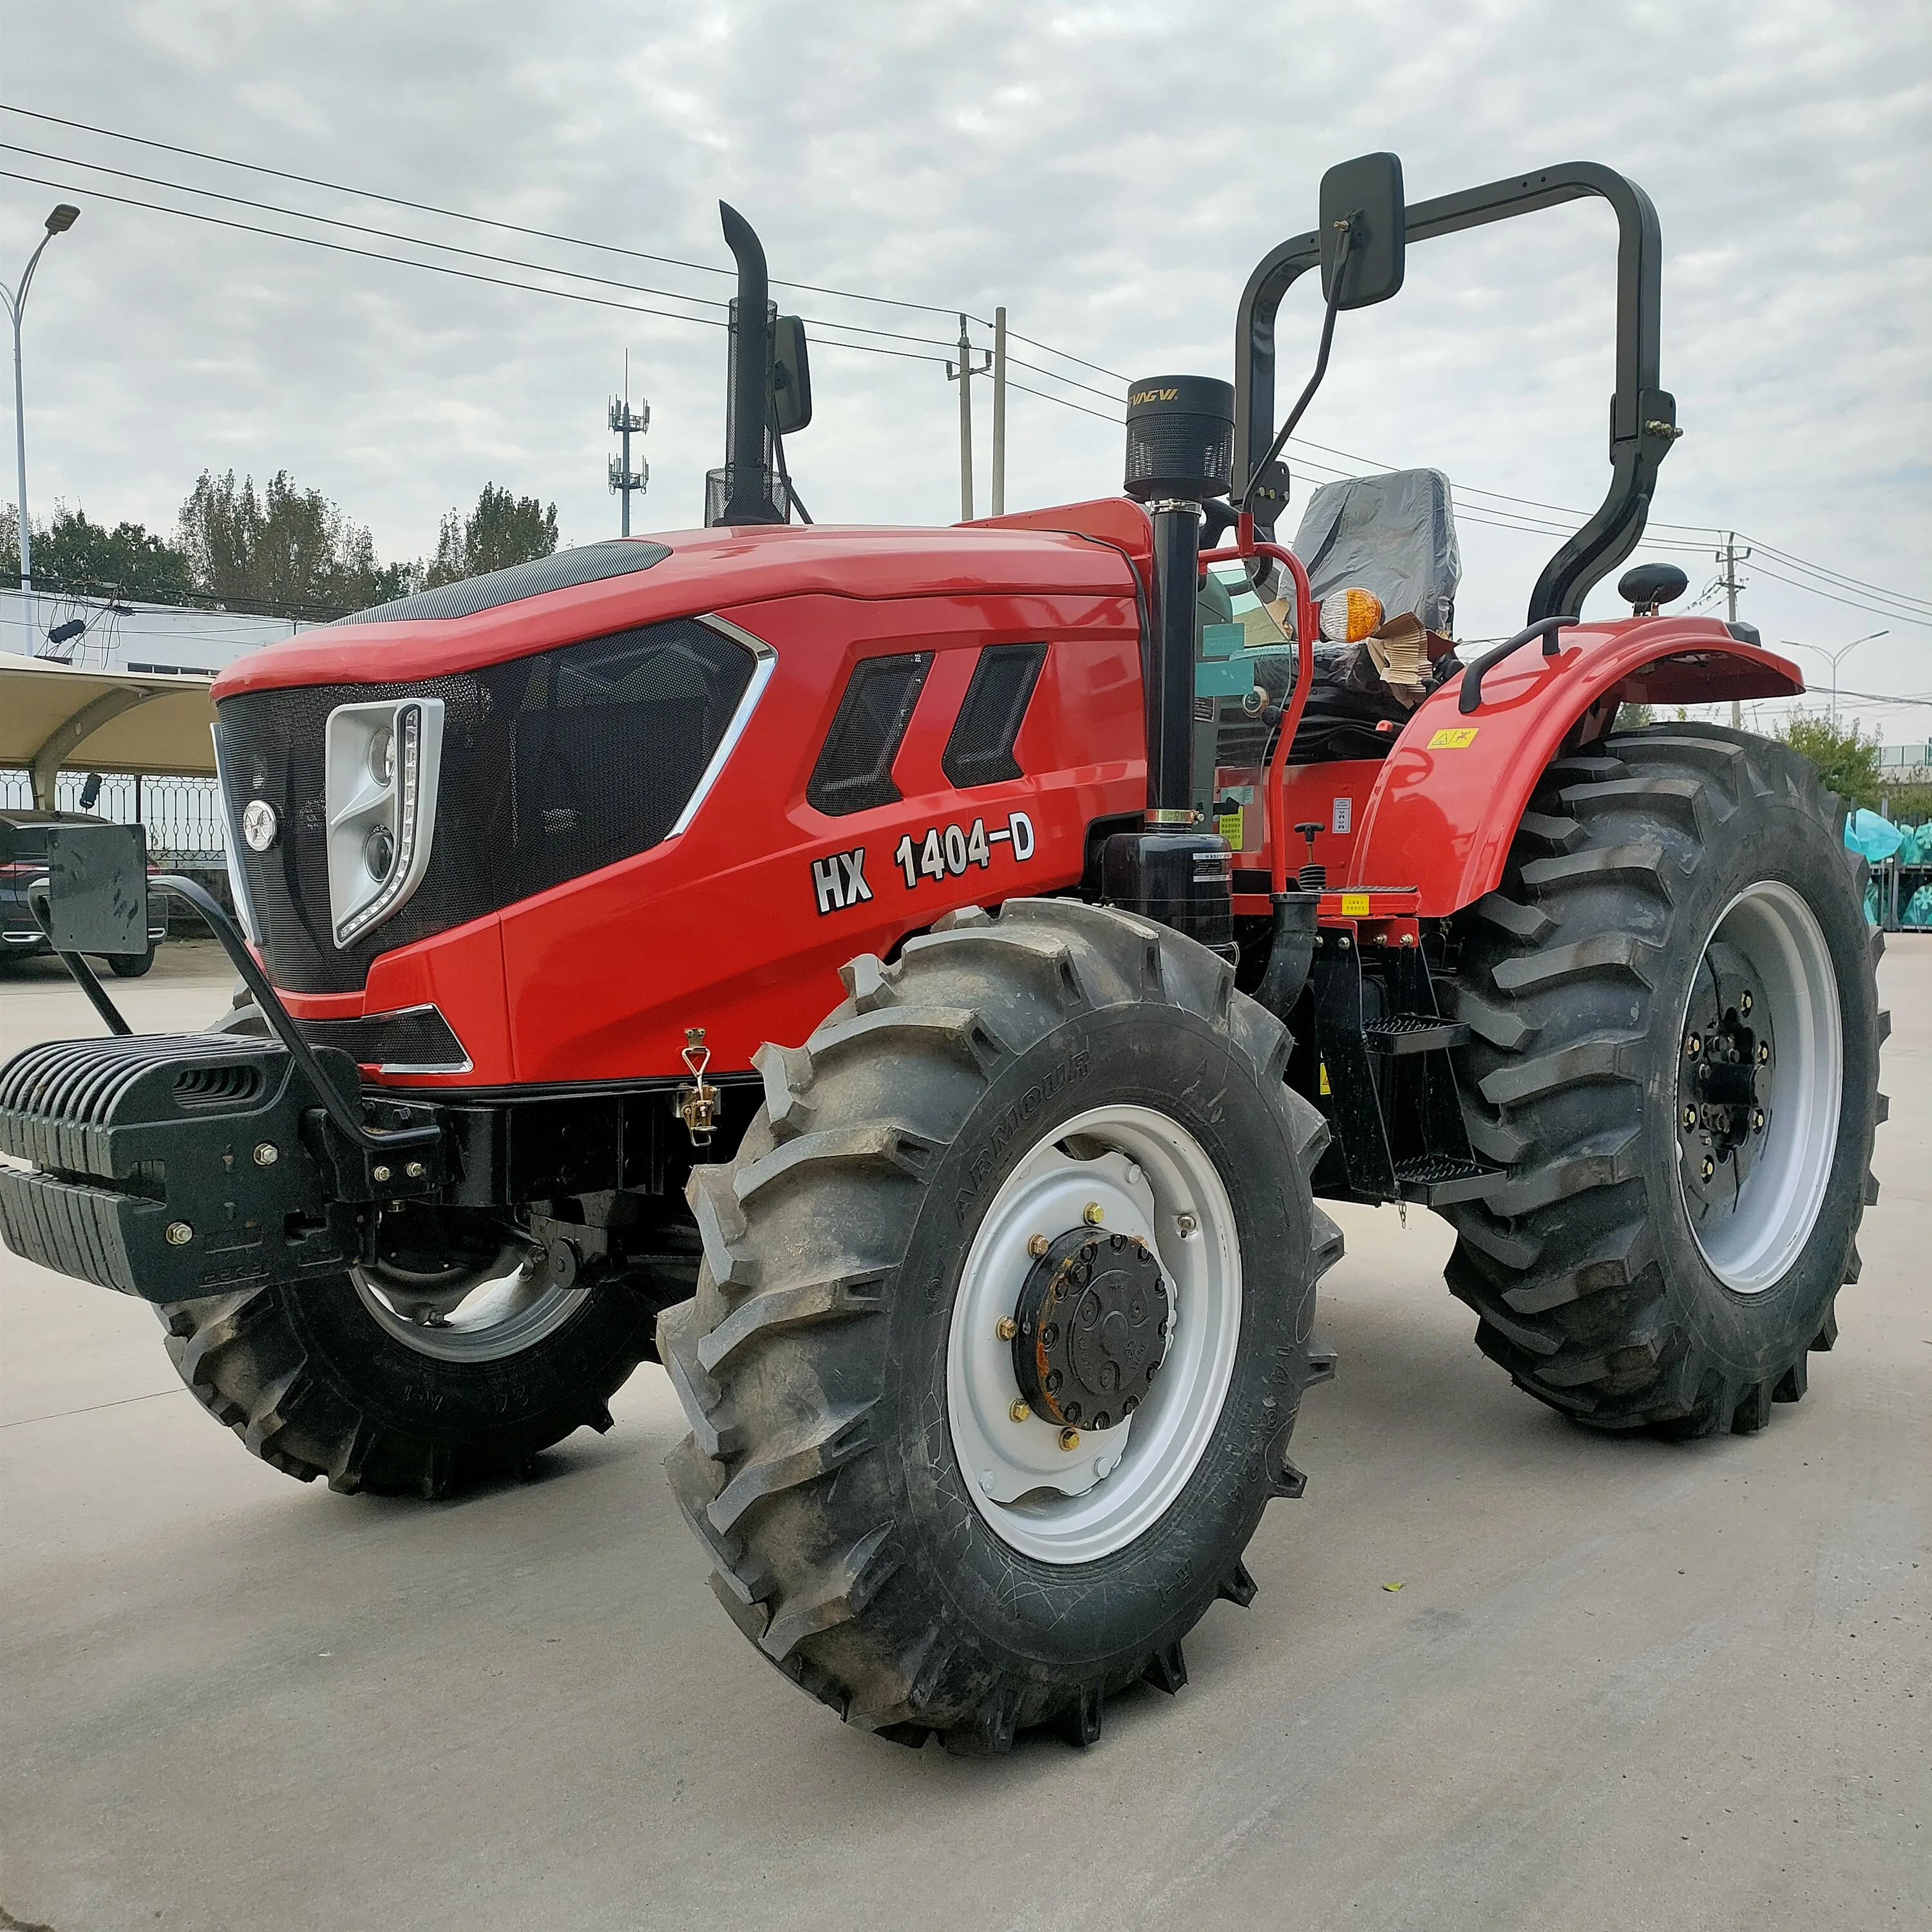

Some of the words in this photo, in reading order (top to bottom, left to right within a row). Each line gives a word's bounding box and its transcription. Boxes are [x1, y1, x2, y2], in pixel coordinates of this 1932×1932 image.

[811, 848, 873, 915] HX
[895, 811, 1035, 889] 1404-D
[955, 1050, 1091, 1227] ARMOUR
